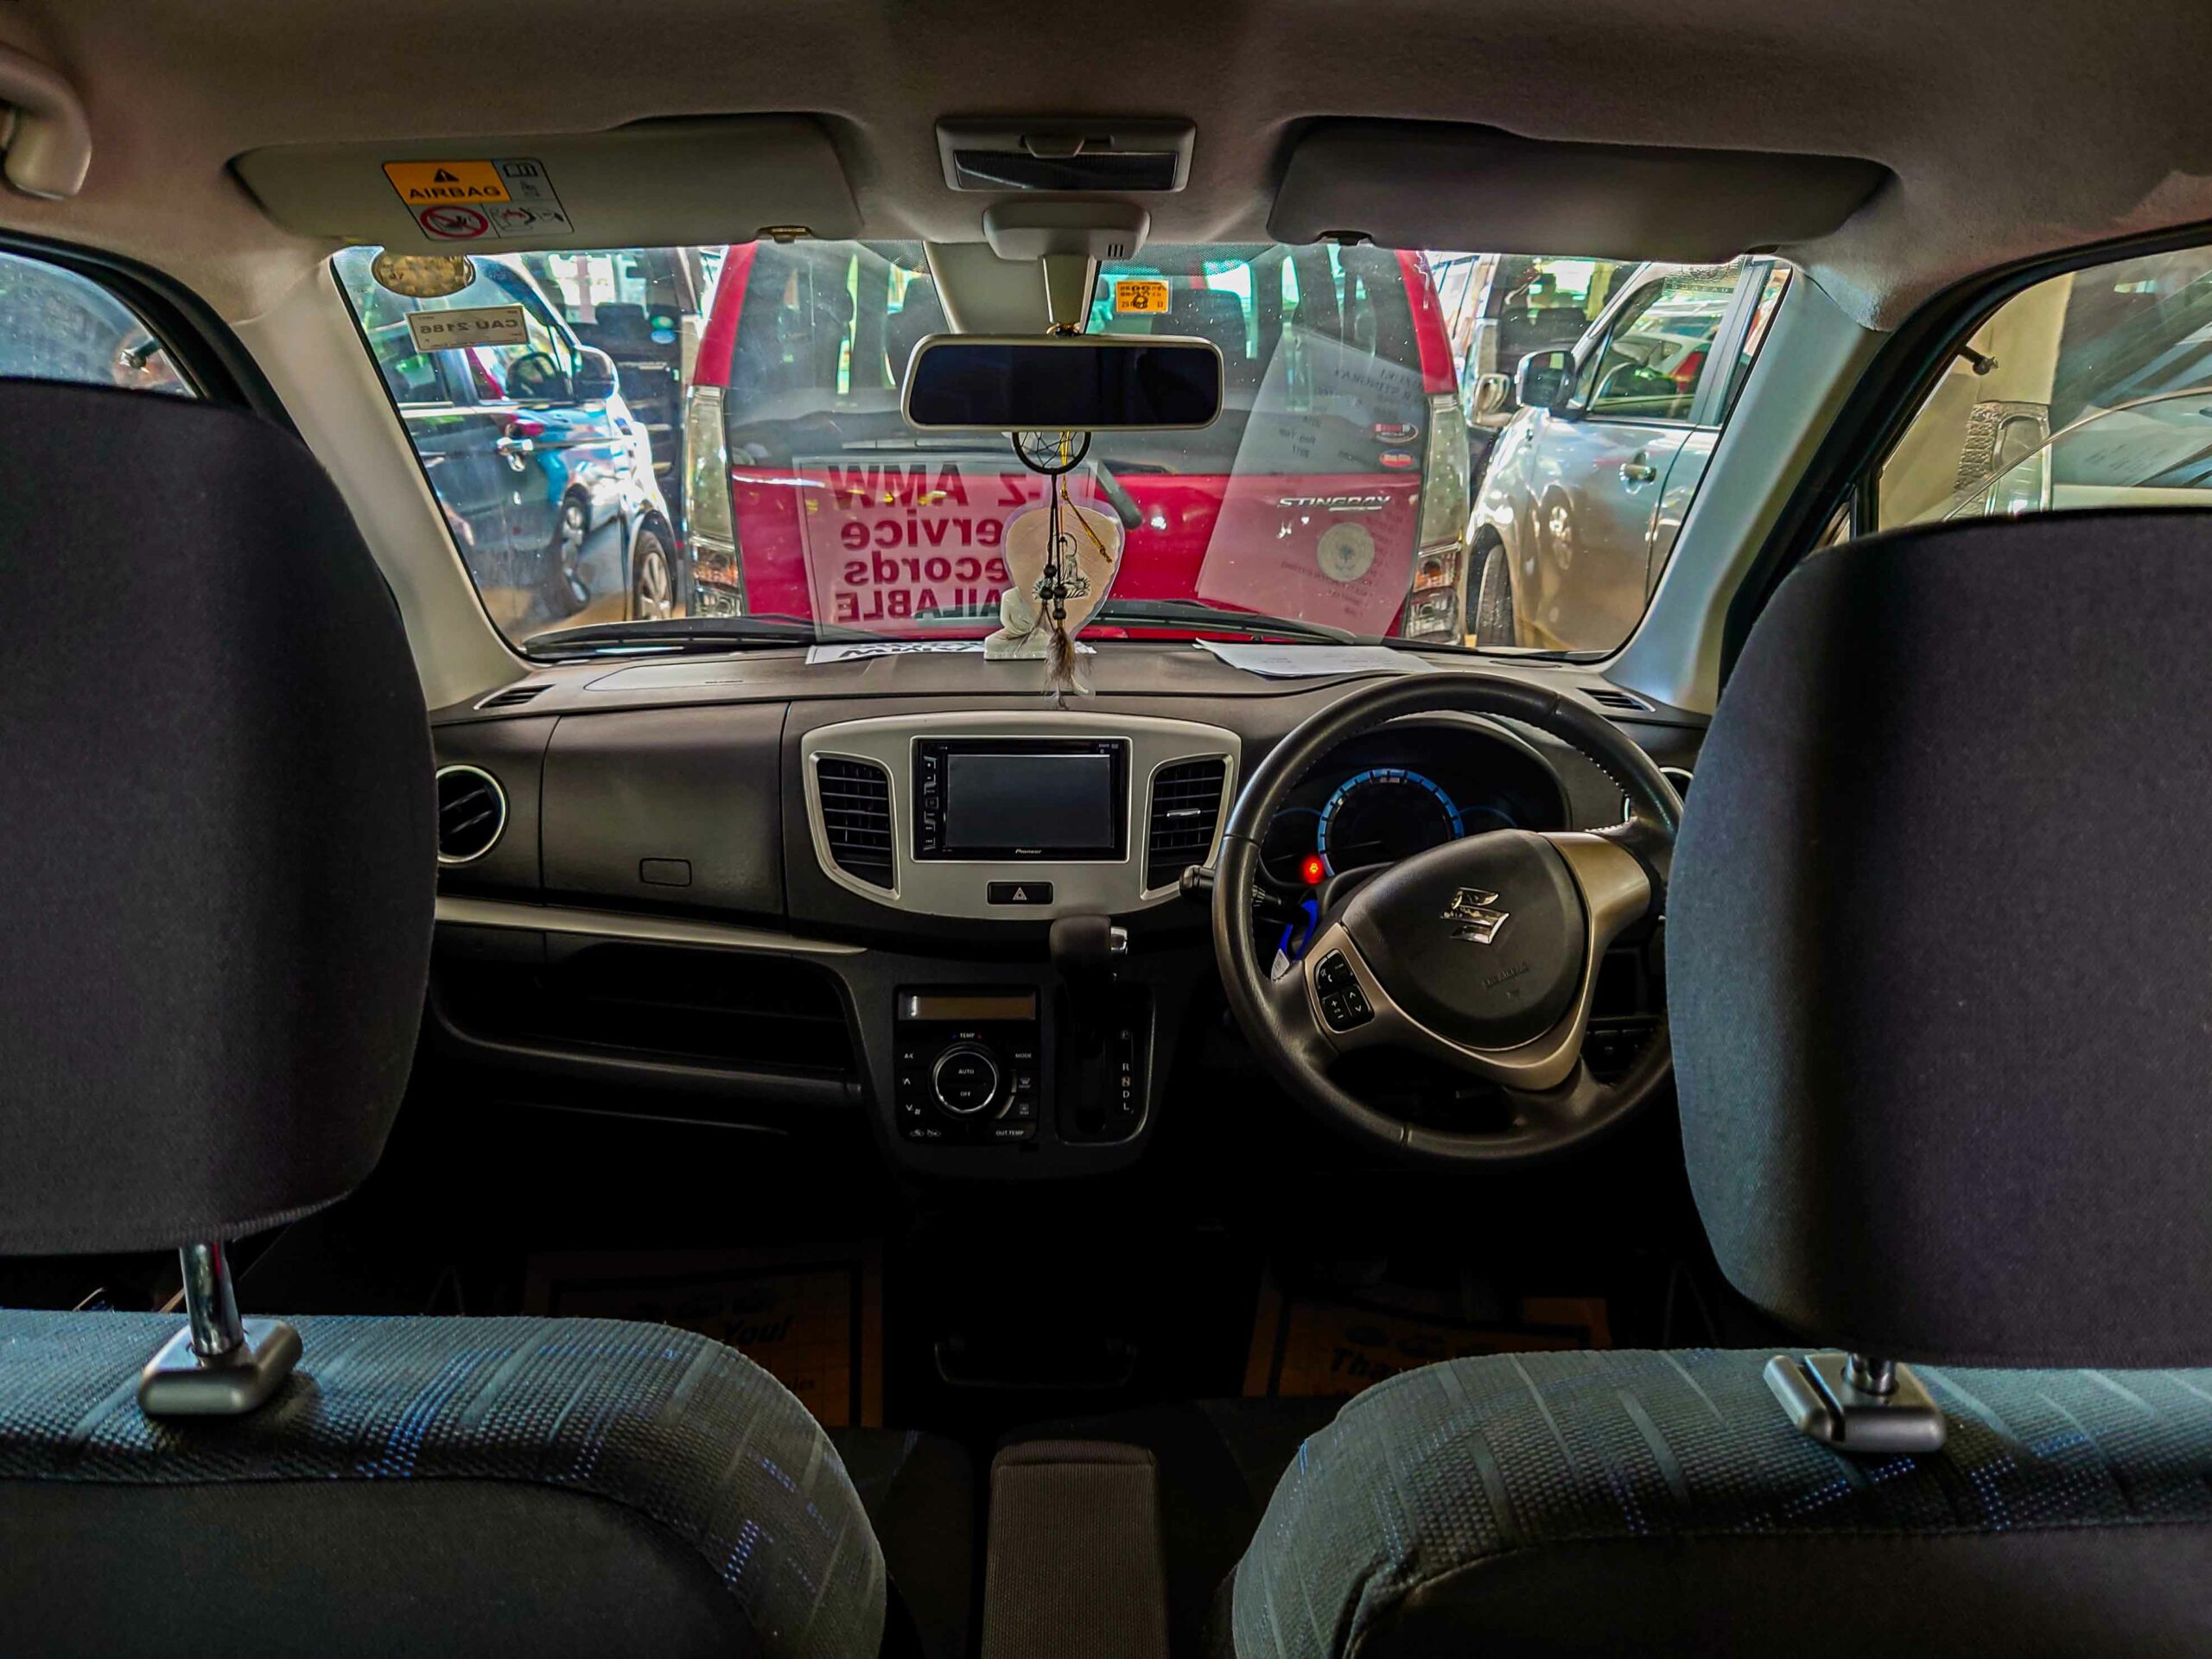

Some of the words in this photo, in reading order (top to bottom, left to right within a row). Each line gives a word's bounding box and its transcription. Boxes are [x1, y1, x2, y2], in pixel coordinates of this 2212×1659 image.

[409, 186, 501, 199] AIRBAG
[1278, 495, 1392, 507] STINGRAY
[1122, 1063, 1130, 1071] R
[1122, 1077, 1131, 1087] N
[1122, 1090, 1130, 1098] D
[1123, 1102, 1130, 1110] L
